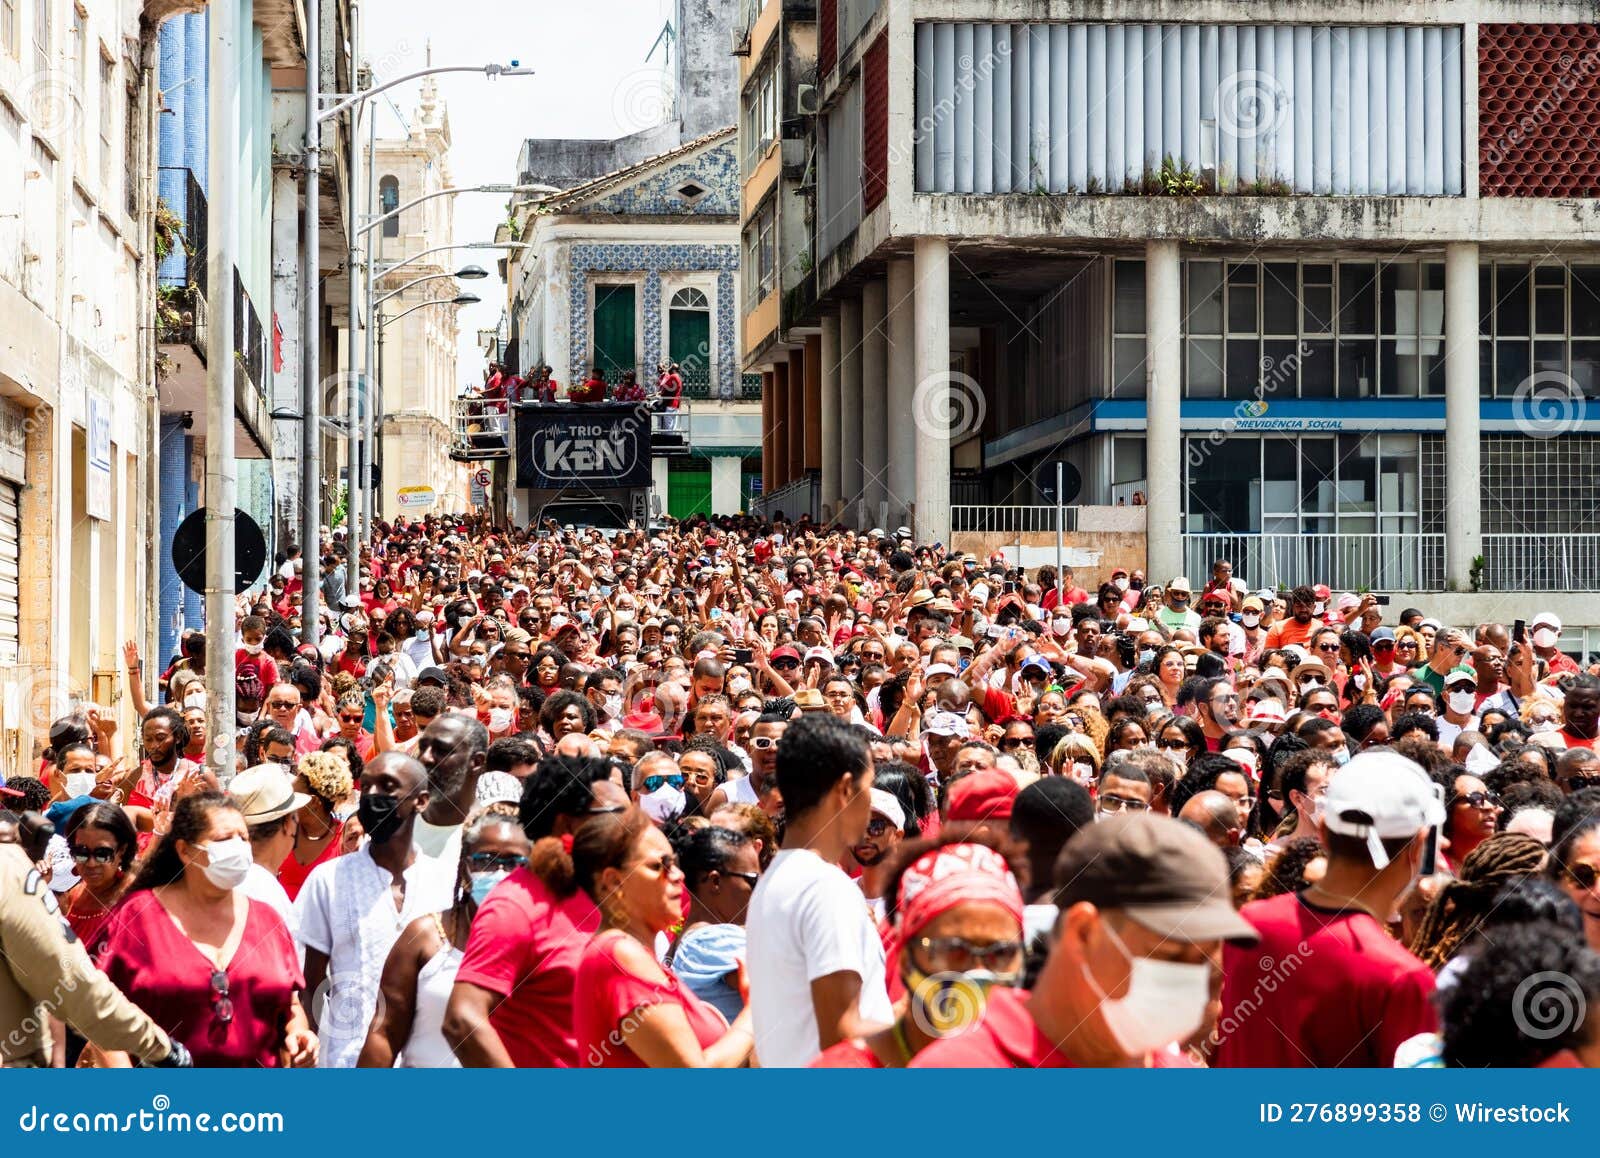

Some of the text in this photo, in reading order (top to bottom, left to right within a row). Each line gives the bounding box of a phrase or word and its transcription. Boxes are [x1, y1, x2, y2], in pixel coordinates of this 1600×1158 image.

[1235, 418, 1342, 428] PREVIDÊNCIA SOCIAL
[569, 426, 602, 436] TRIO
[545, 440, 624, 471] KEN
